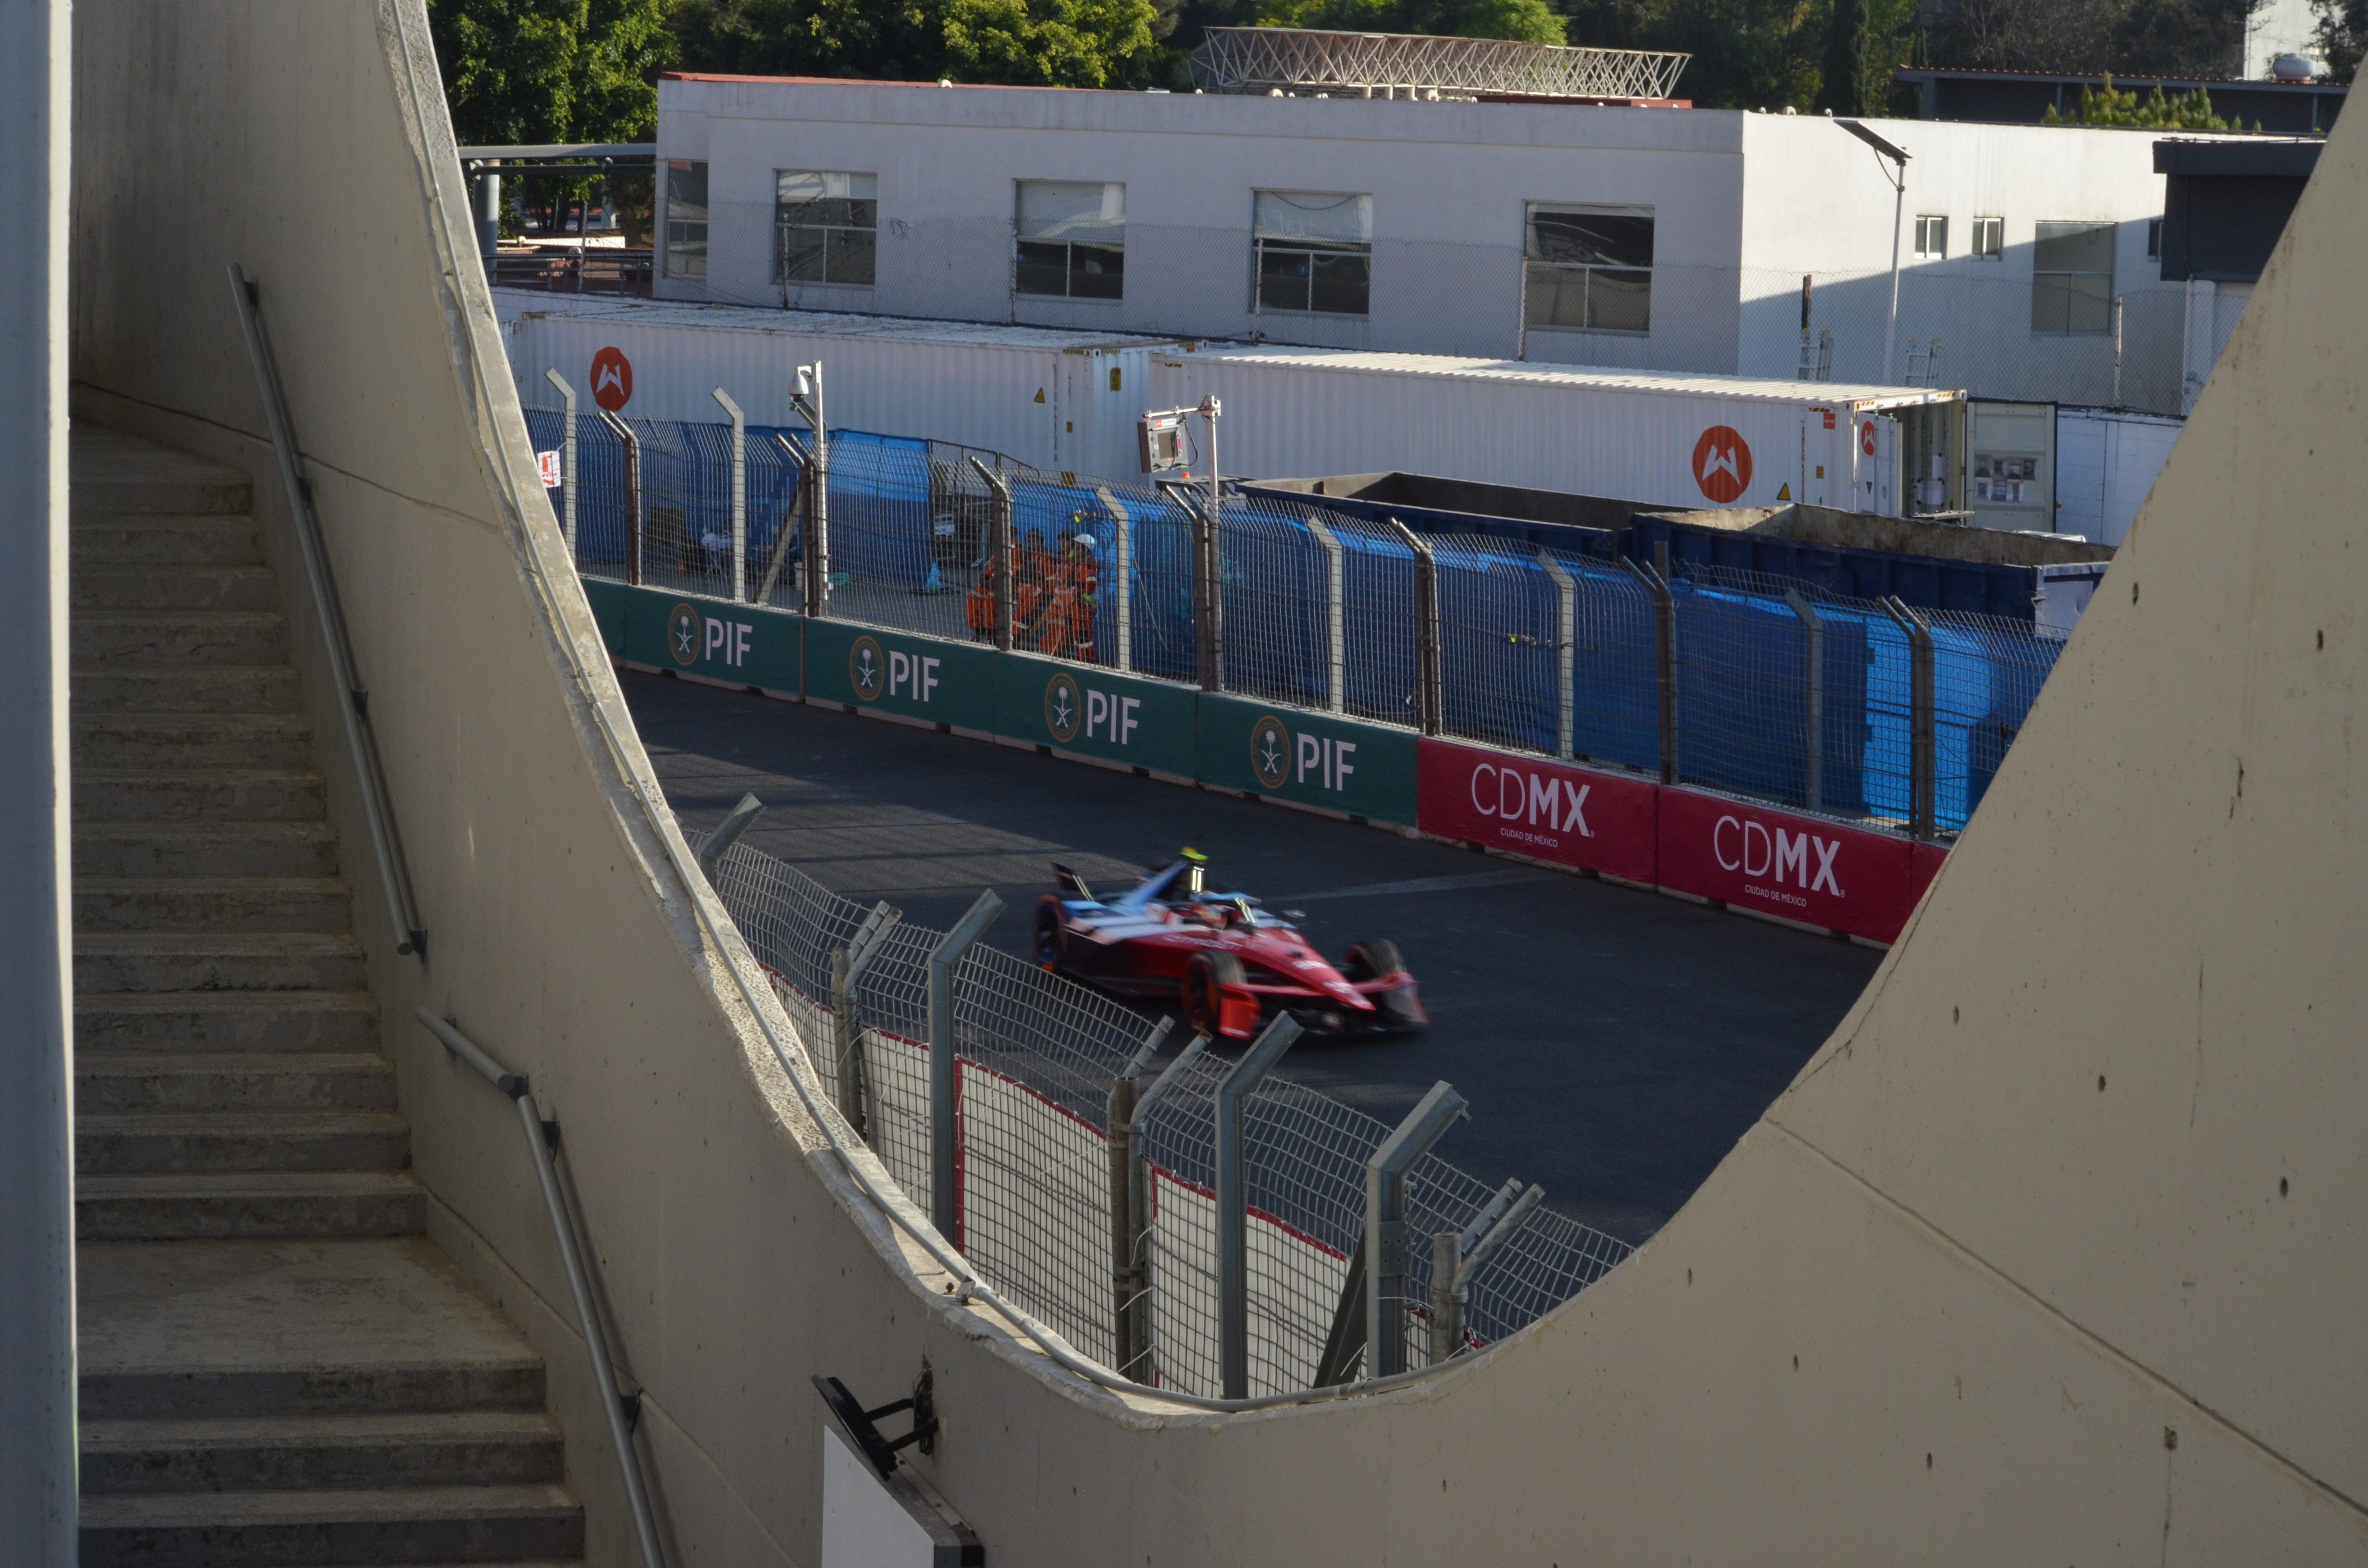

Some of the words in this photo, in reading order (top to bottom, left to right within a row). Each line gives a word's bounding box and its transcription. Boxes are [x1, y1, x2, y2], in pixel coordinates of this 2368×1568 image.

[705, 617, 752, 666] PIF
[889, 650, 940, 702] PIF
[1087, 689, 1141, 745] PIF
[1297, 733, 1357, 791] PIF
[1472, 763, 1591, 837] CDMX
[1500, 827, 1524, 840] CIUDAD
[1525, 833, 1533, 843] DE
[1534, 834, 1558, 848] MÉXICO
[1714, 815, 1840, 896] CDMX
[1745, 884, 1769, 898] CIUDAD
[1771, 891, 1780, 901] DE
[1781, 893, 1807, 907] MÉXICO
